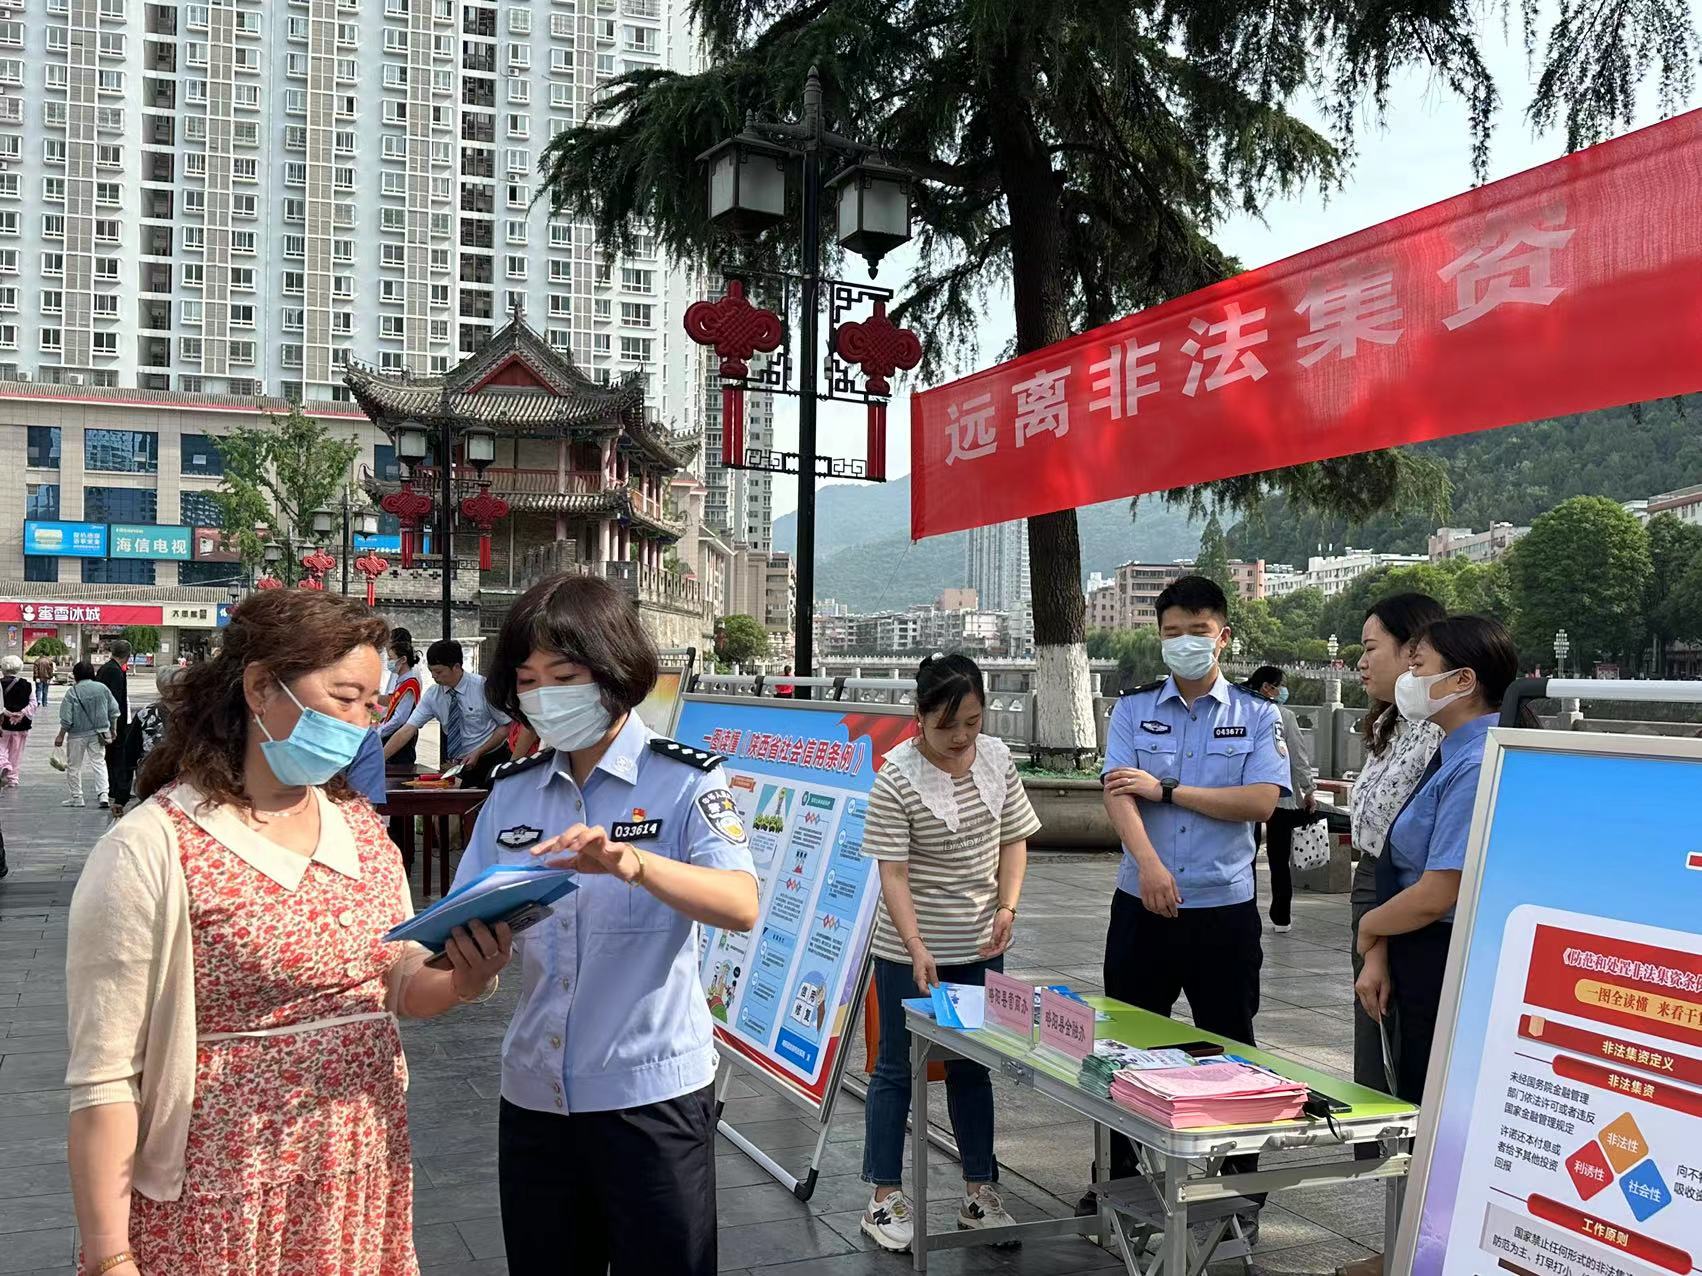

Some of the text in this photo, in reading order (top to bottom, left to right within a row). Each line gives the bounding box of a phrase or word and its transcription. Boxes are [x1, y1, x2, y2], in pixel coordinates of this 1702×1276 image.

[945, 205, 1576, 467] 远离非法集资
[116, 537, 187, 554] 海信电视
[38, 606, 100, 621] 蜜雪冰城
[614, 823, 657, 838] 033614
[1586, 987, 1702, 1026] 一图全读懂 来看干
[1602, 1040, 1674, 1071] 非法集资定义
[1509, 1071, 1590, 1105] 未经国务院金融管理
[1608, 1074, 1655, 1099] 非法集资
[1504, 1102, 1575, 1135] 国家金融管理规定
[1506, 1087, 1596, 1125] 部门依法许可或者违反
[1500, 1124, 1562, 1156] 许诺还本付息或
[1606, 1132, 1640, 1154] 非法性
[1494, 1156, 1513, 1172] 回报
[1497, 1141, 1560, 1172] 者给予其他投资
[1573, 1159, 1605, 1183] 利诱性
[1628, 1179, 1662, 1203] 社会性
[1581, 1218, 1629, 1247] 工作原则
